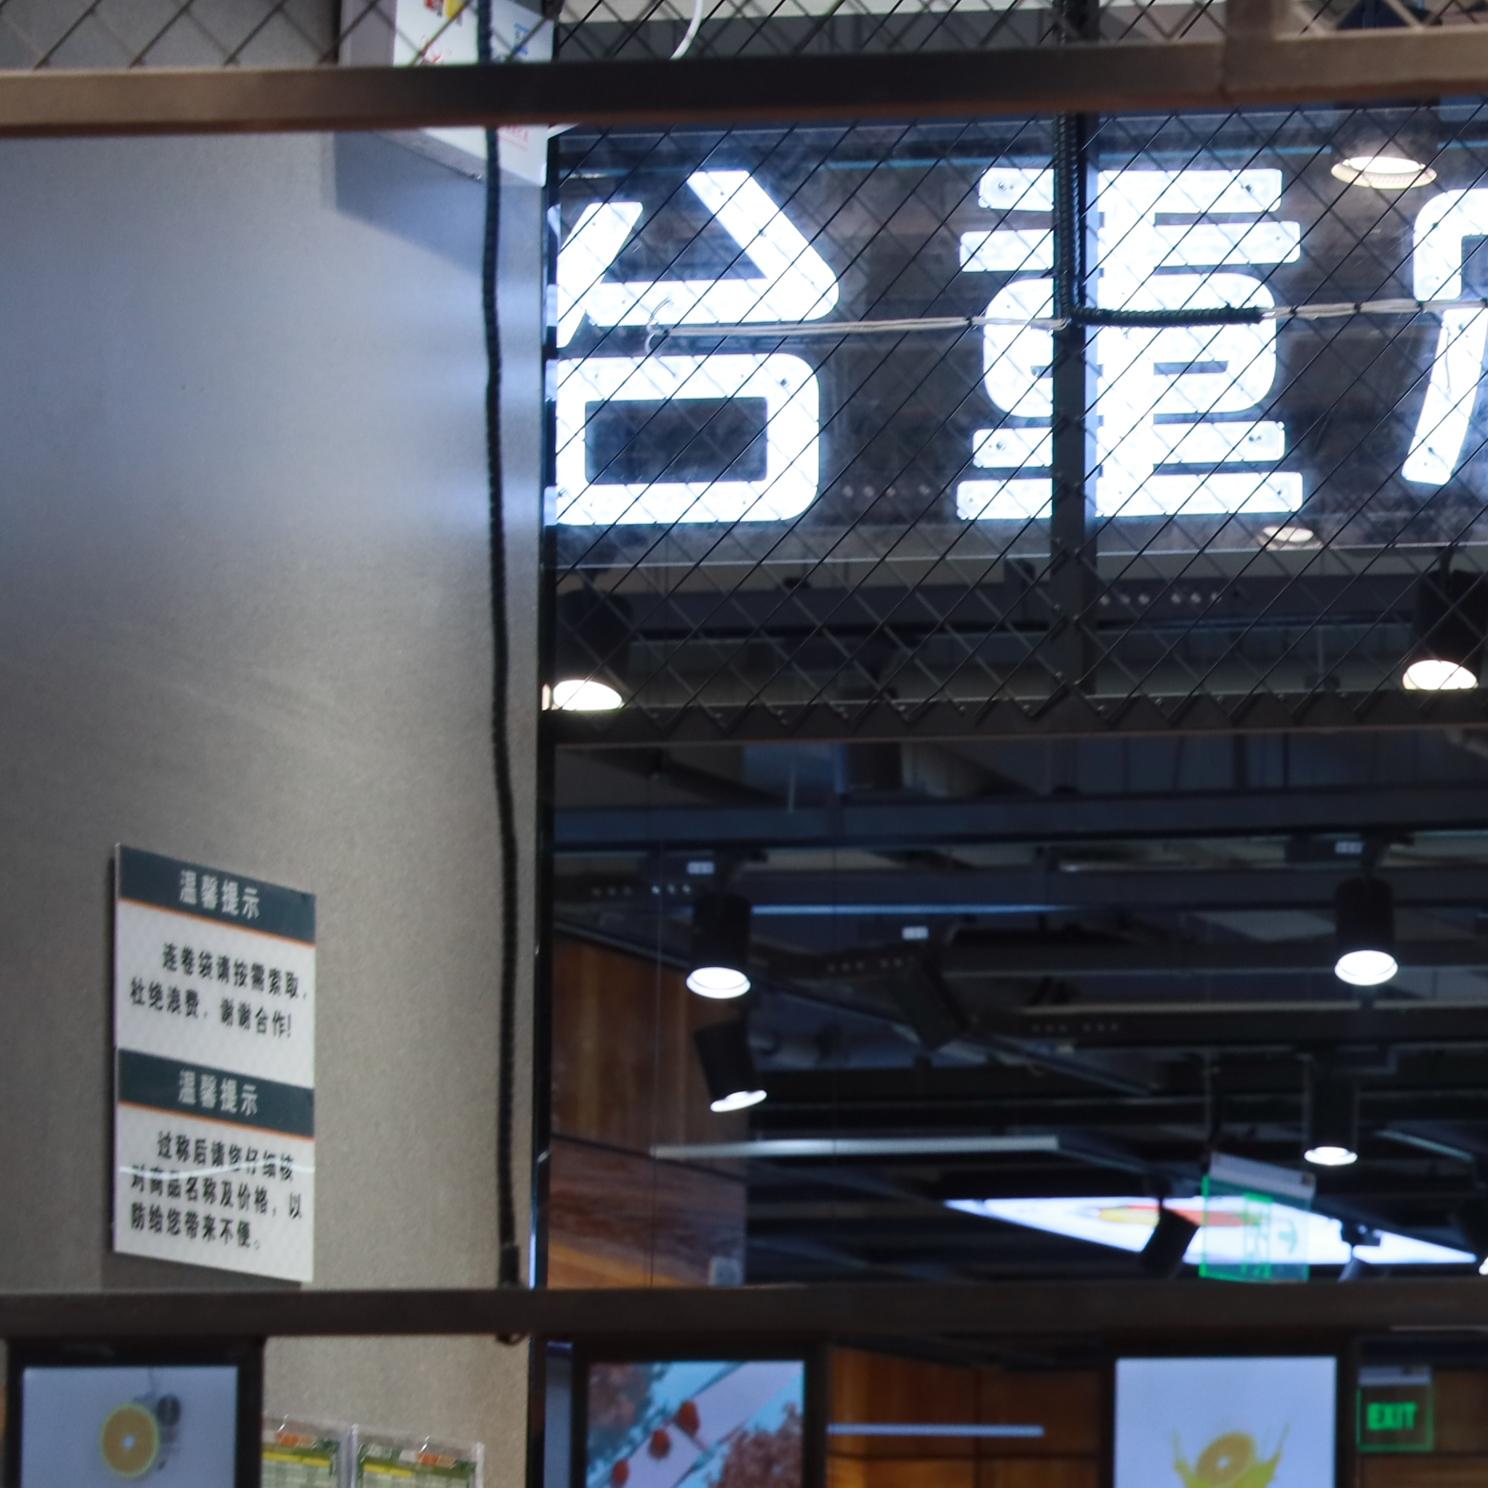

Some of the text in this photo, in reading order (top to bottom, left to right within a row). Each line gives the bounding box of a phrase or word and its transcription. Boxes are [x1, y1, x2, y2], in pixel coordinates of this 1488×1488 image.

[179, 869, 260, 919] 温馨提示
[178, 1068, 258, 1116] 温馨提示
[1368, 1402, 1418, 1431] EXIT
